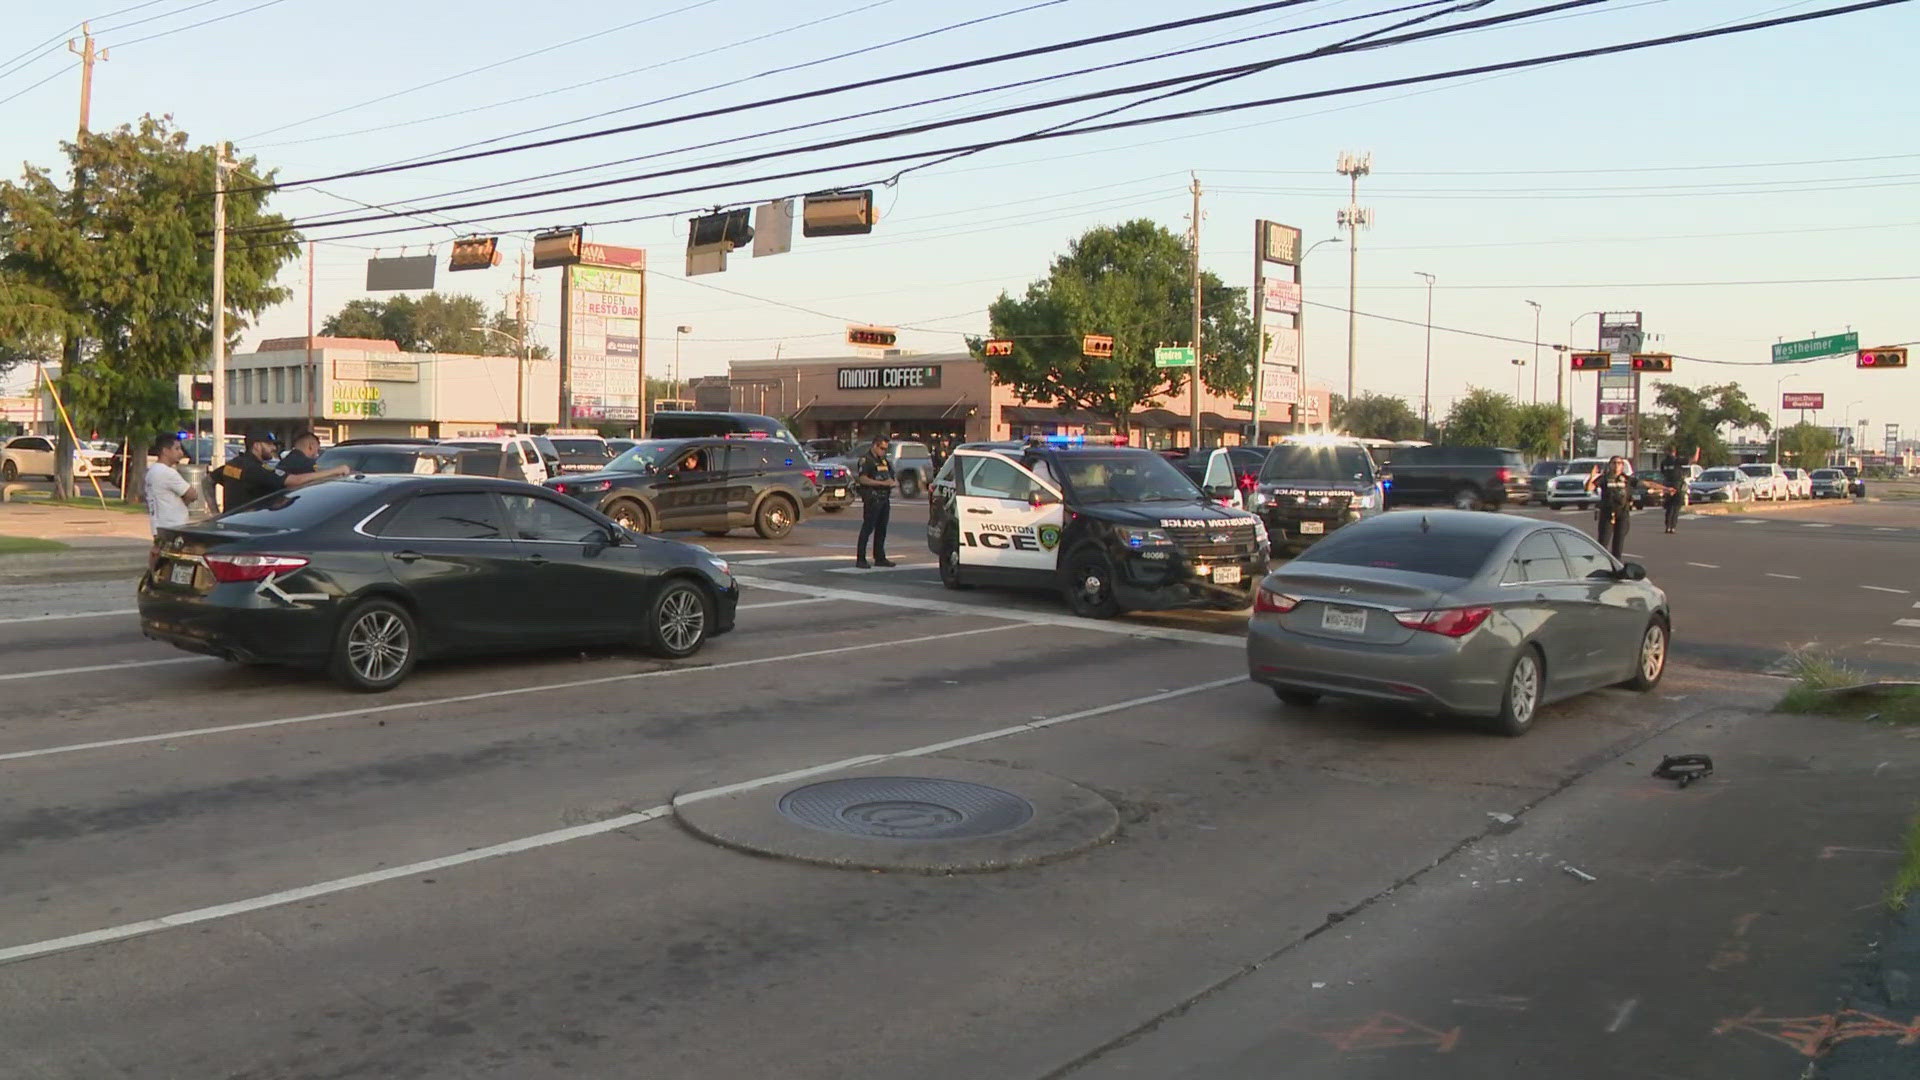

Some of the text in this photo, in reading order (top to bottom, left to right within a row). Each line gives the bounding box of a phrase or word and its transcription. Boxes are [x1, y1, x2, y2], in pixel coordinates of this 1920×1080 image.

[1270, 240, 1293, 261] COFFEE
[601, 295, 625, 305] EDEN
[589, 304, 638, 316] RESTO BAR
[1774, 340, 1832, 355] Westheimer
[840, 368, 924, 388] MINUTI COFFEE
[333, 386, 380, 400] DIAMOND
[981, 523, 1034, 535] HOUSTON
[959, 531, 1040, 552] ICE
